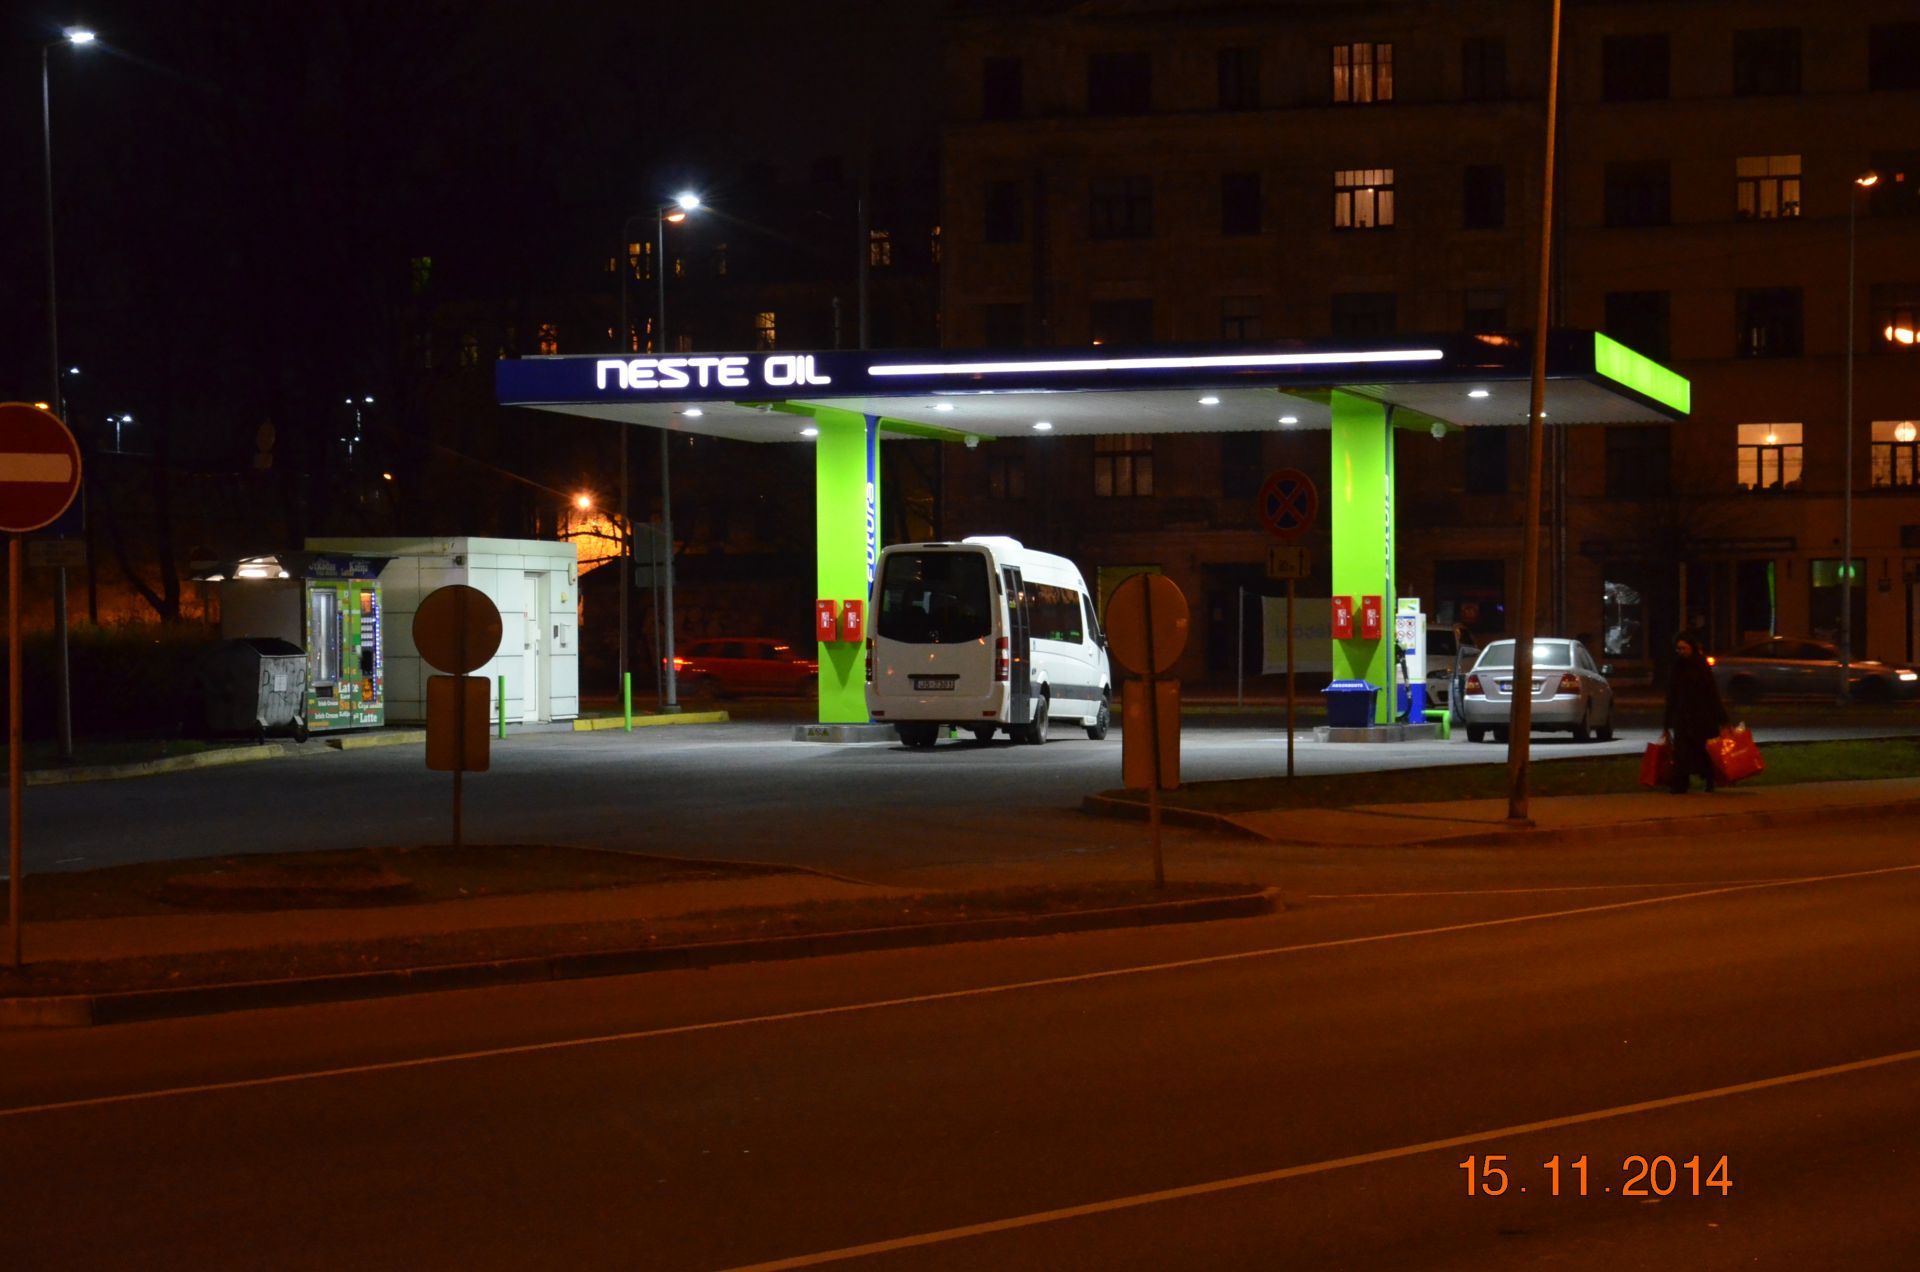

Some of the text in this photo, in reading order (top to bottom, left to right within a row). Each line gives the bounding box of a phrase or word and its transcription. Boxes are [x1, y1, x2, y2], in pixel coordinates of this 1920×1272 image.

[597, 355, 831, 389] NESTE OIL
[359, 713, 378, 723] Latte
